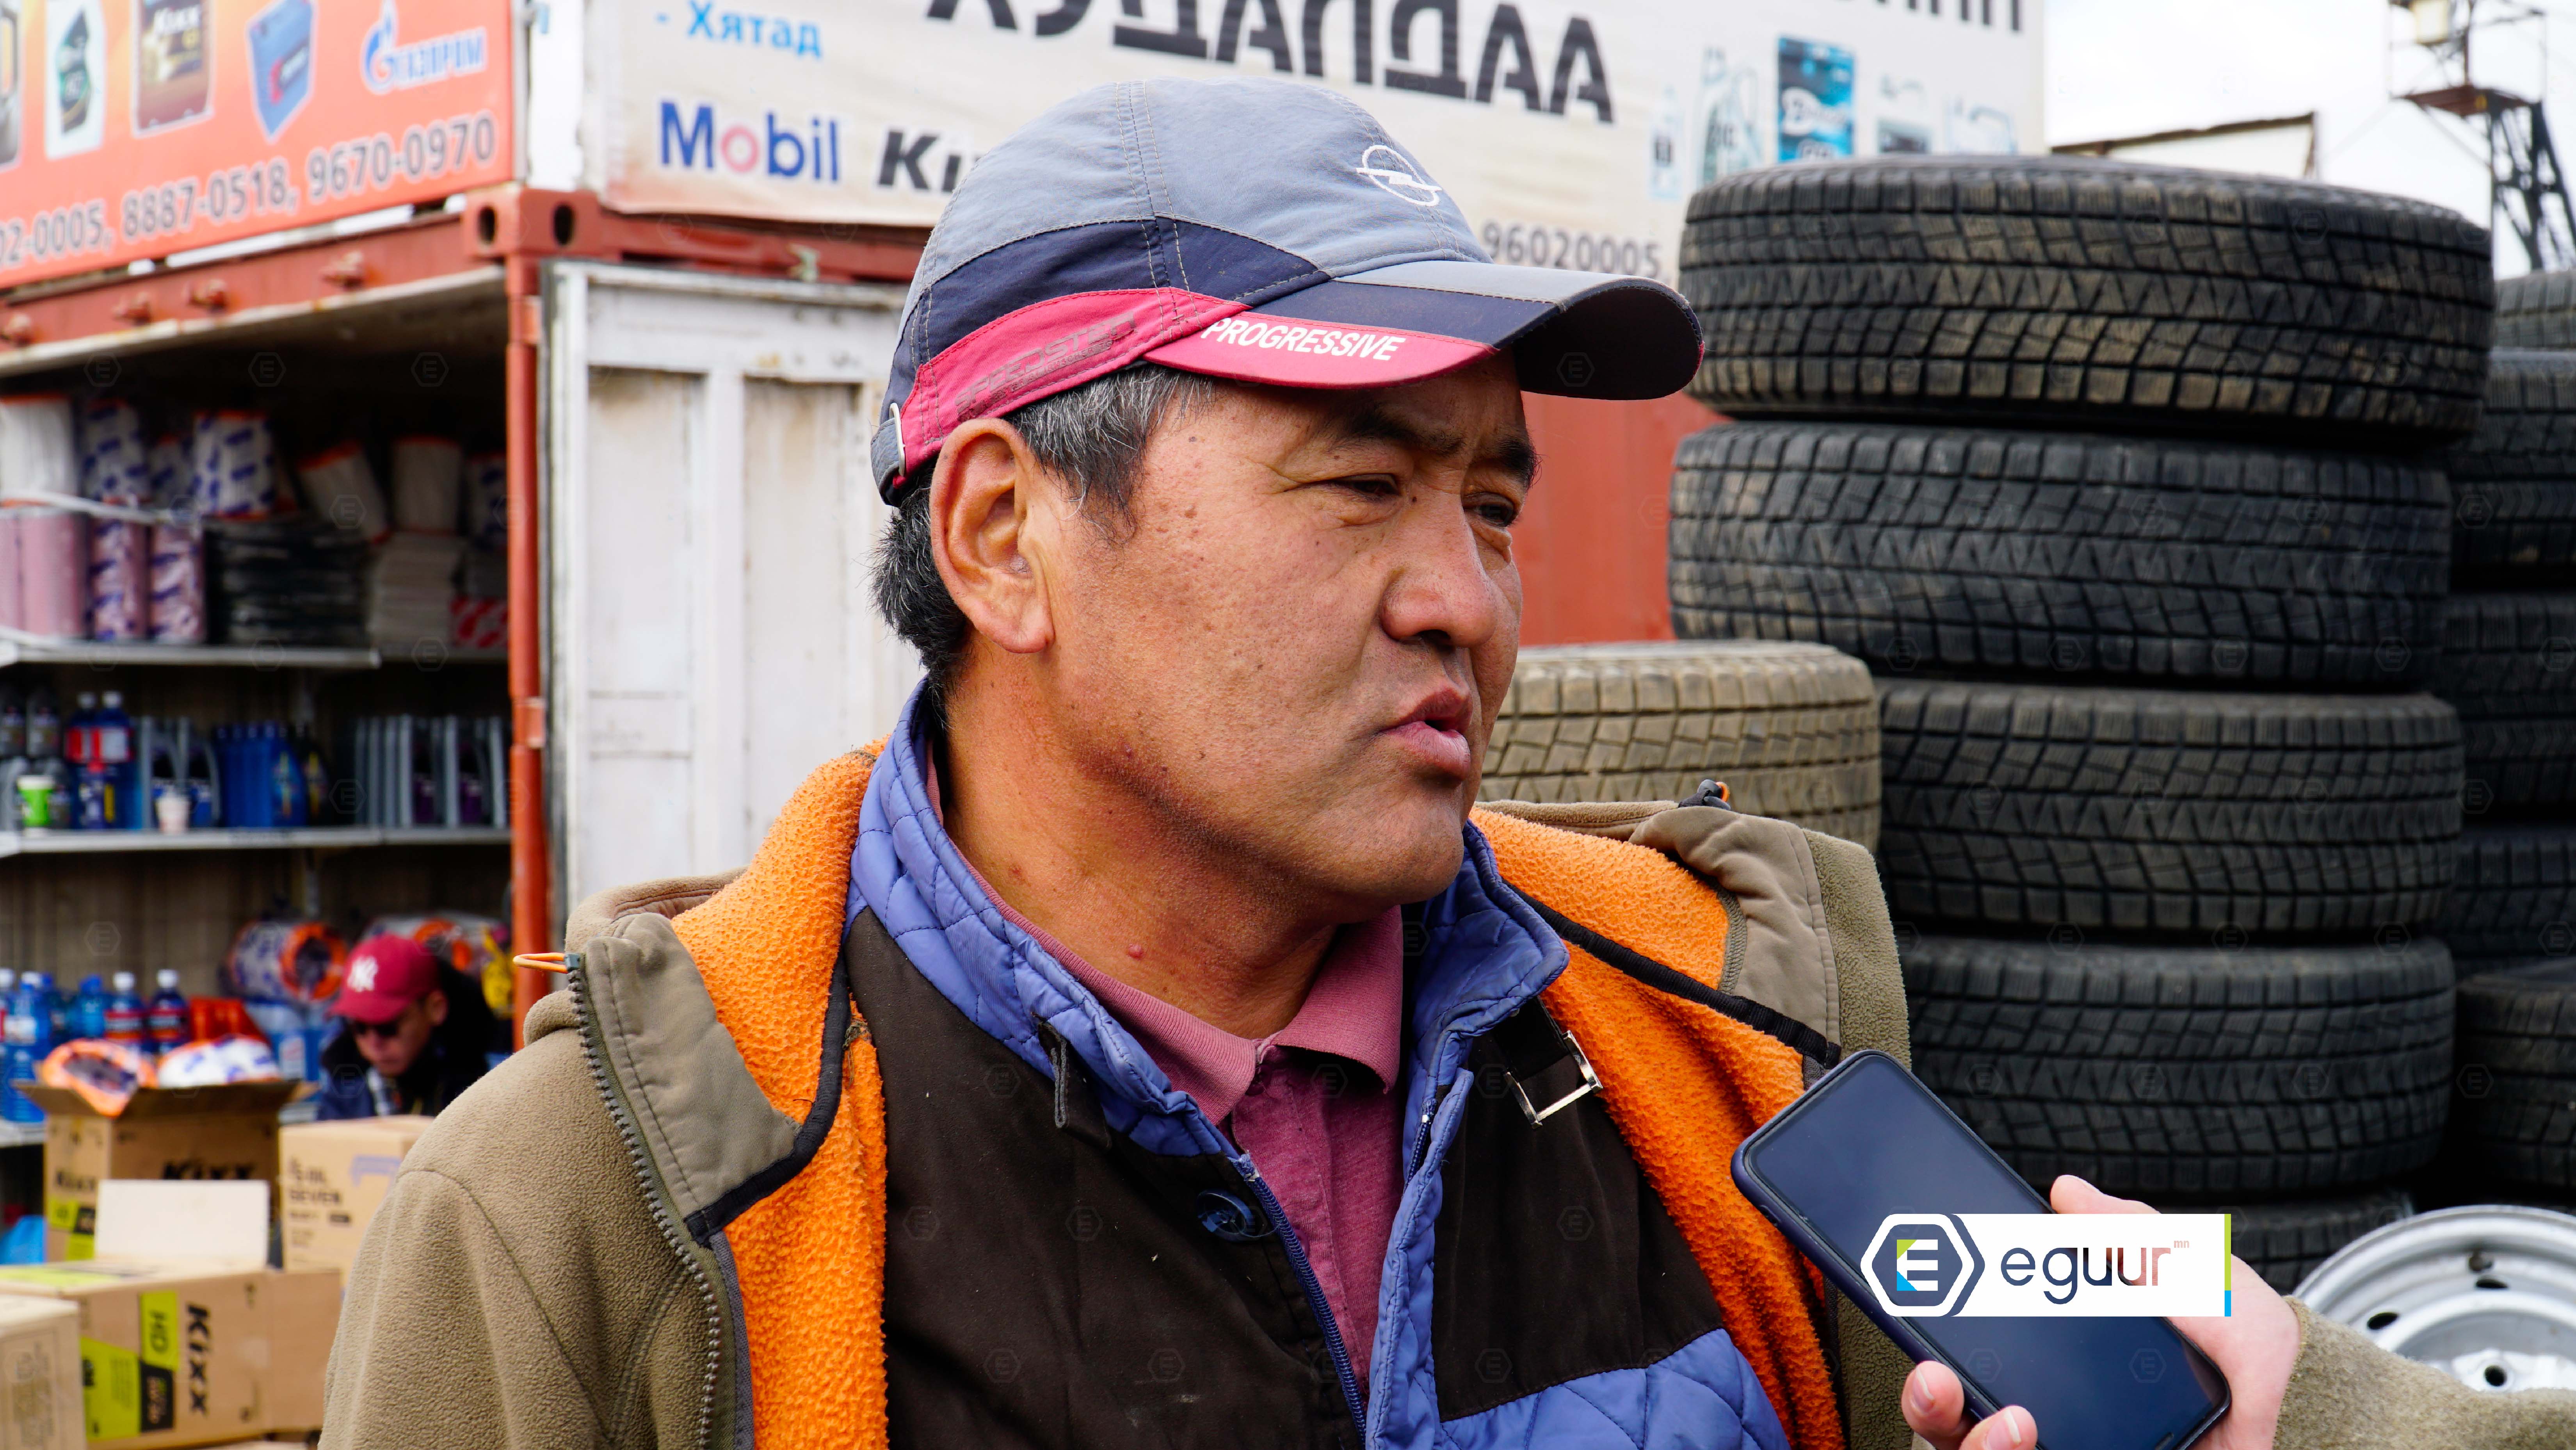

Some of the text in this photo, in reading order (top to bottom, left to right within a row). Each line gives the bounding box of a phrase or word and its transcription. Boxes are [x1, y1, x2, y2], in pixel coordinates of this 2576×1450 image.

[927, 0, 1613, 123] ДАЛДАА
[309, 116, 495, 196] 9670-0970
[660, 100, 839, 183] Mobil
[1201, 317, 1406, 361] PROGRESSIVE
[187, 1303, 212, 1416] Kixx
